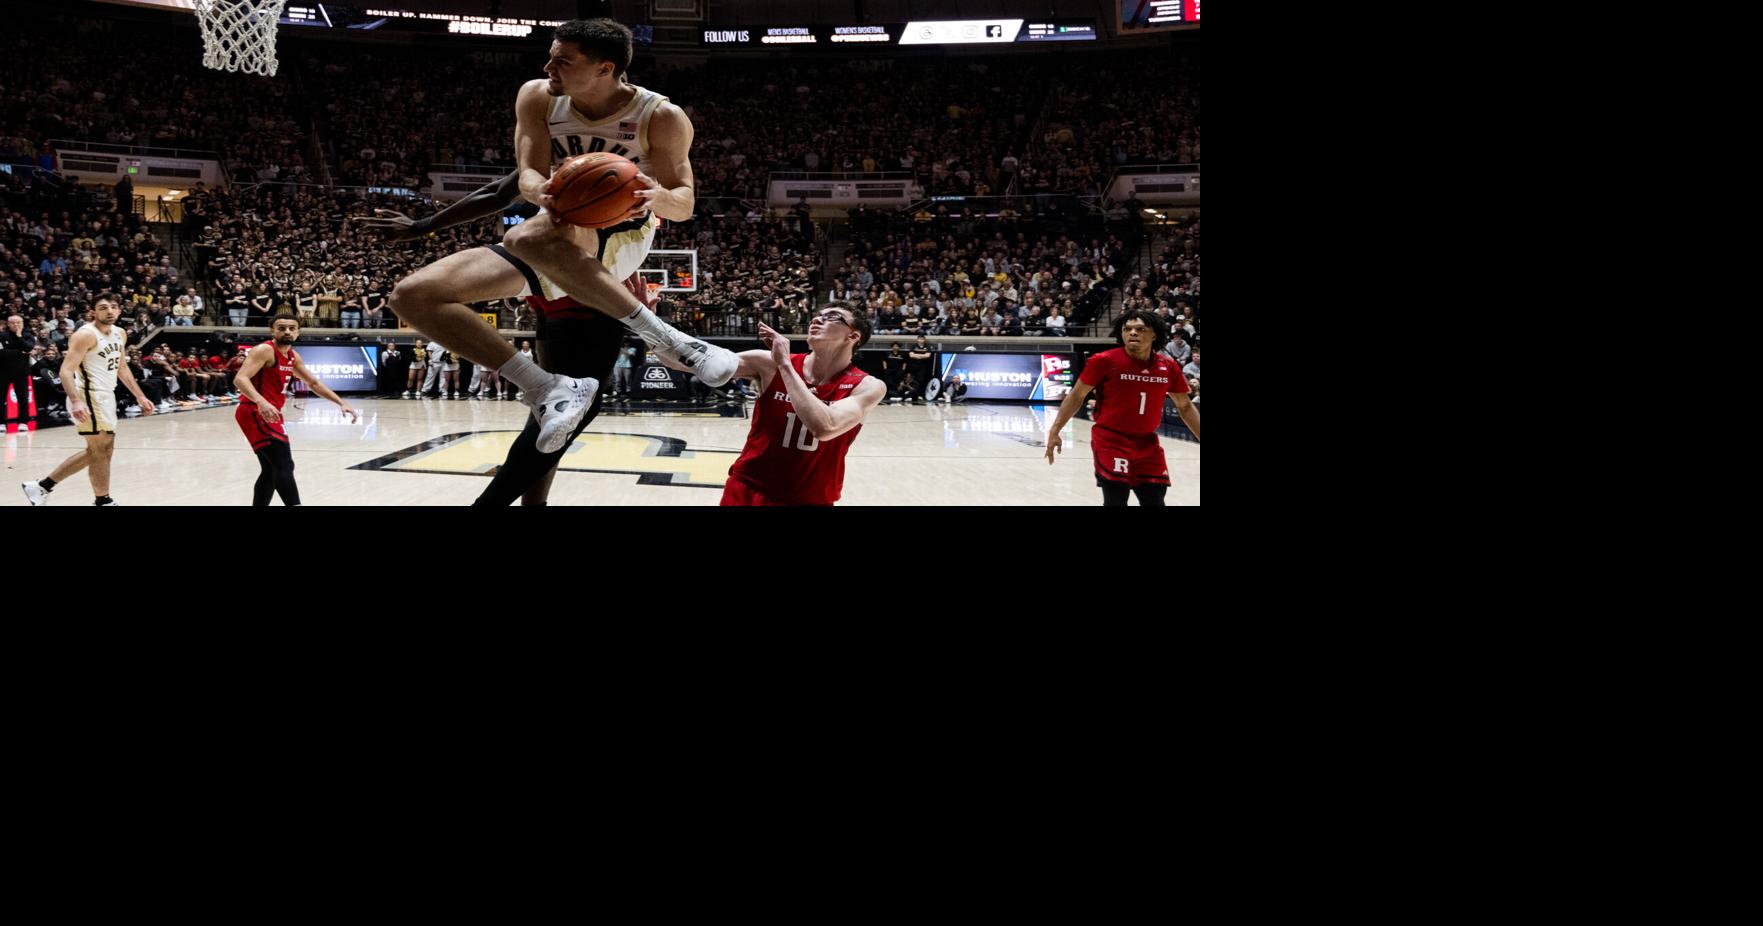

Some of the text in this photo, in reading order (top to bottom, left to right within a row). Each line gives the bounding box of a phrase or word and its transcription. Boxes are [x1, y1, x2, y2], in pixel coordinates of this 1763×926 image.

[366, 9, 400, 17] BOILER
[419, 13, 460, 21] HAMMER
[463, 15, 494, 23] DOWN.
[448, 21, 532, 37] #BOILERUP
[705, 31, 750, 42] FOLLOW US
[98, 343, 121, 359] PURD
[107, 357, 120, 371] 25
[969, 372, 1032, 382] HUSTON
[1120, 373, 1168, 384] RUTGERS
[1139, 392, 1147, 415] 1
[1113, 457, 1129, 473] R
